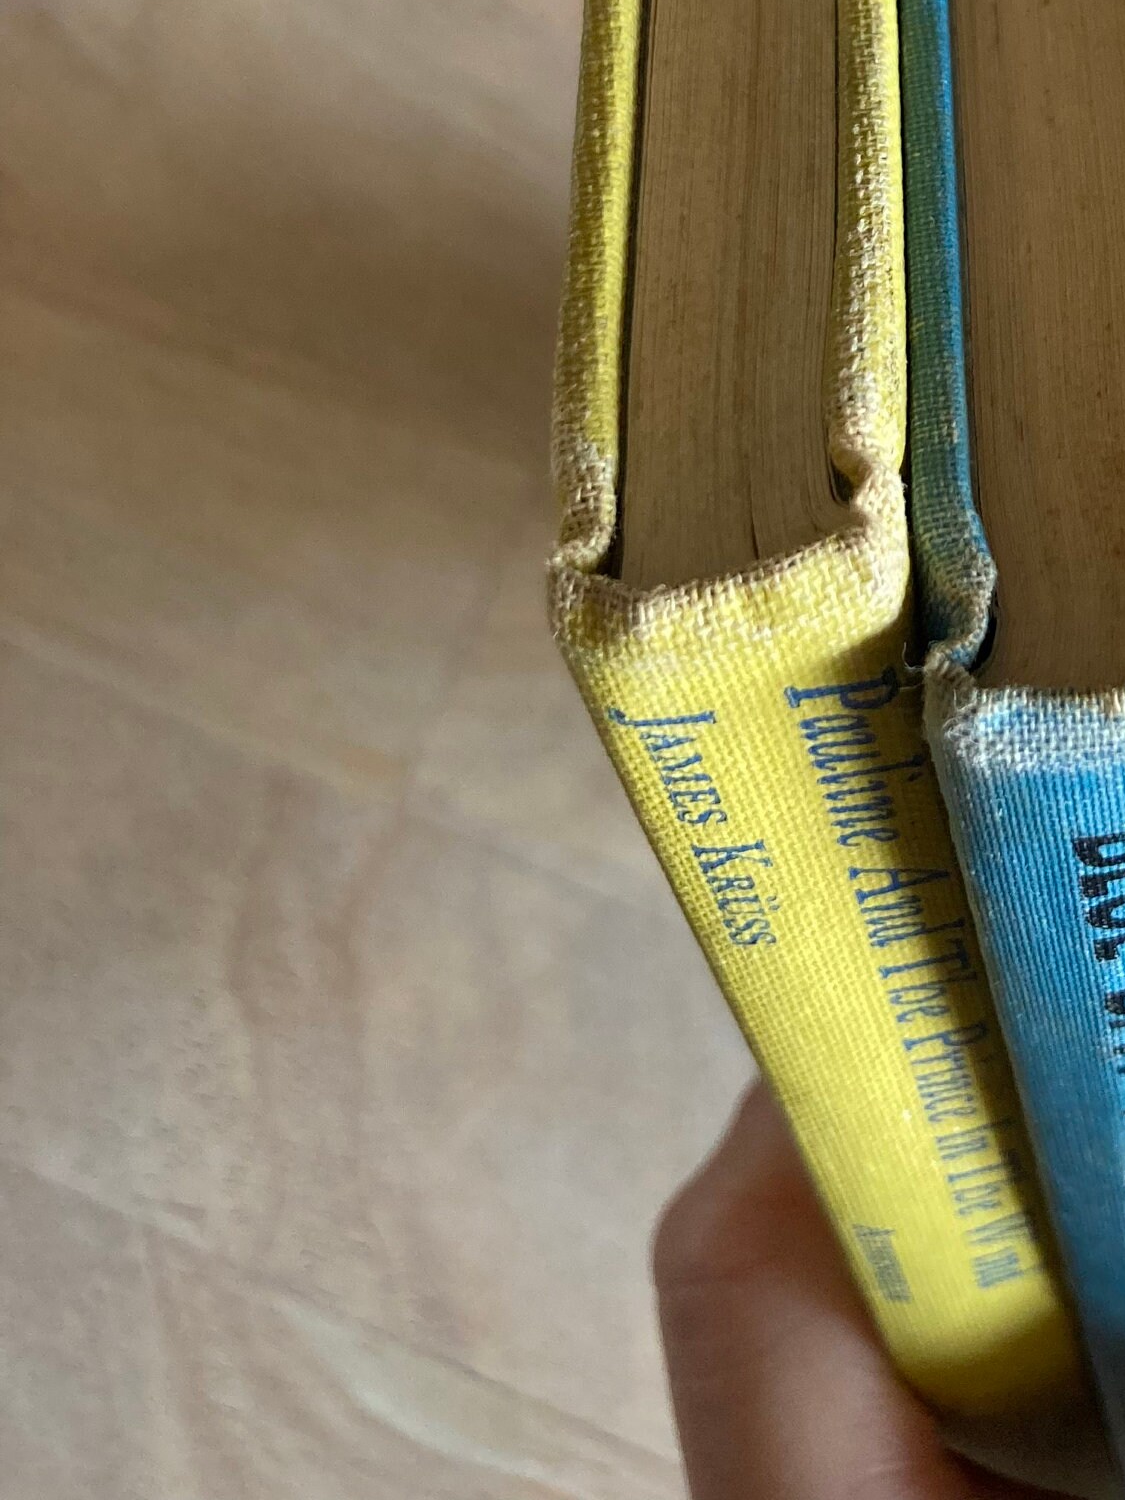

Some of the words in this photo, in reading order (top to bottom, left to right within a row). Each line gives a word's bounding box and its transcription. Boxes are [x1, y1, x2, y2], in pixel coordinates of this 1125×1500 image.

[785, 666, 925, 847] Pauline
[848, 867, 964, 947] And
[878, 938, 977, 1023] The
[902, 1022, 988, 1123] Prince
[935, 1118, 1013, 1161] In
[948, 1156, 1024, 1217] The
[967, 1212, 1043, 1289] Wind
